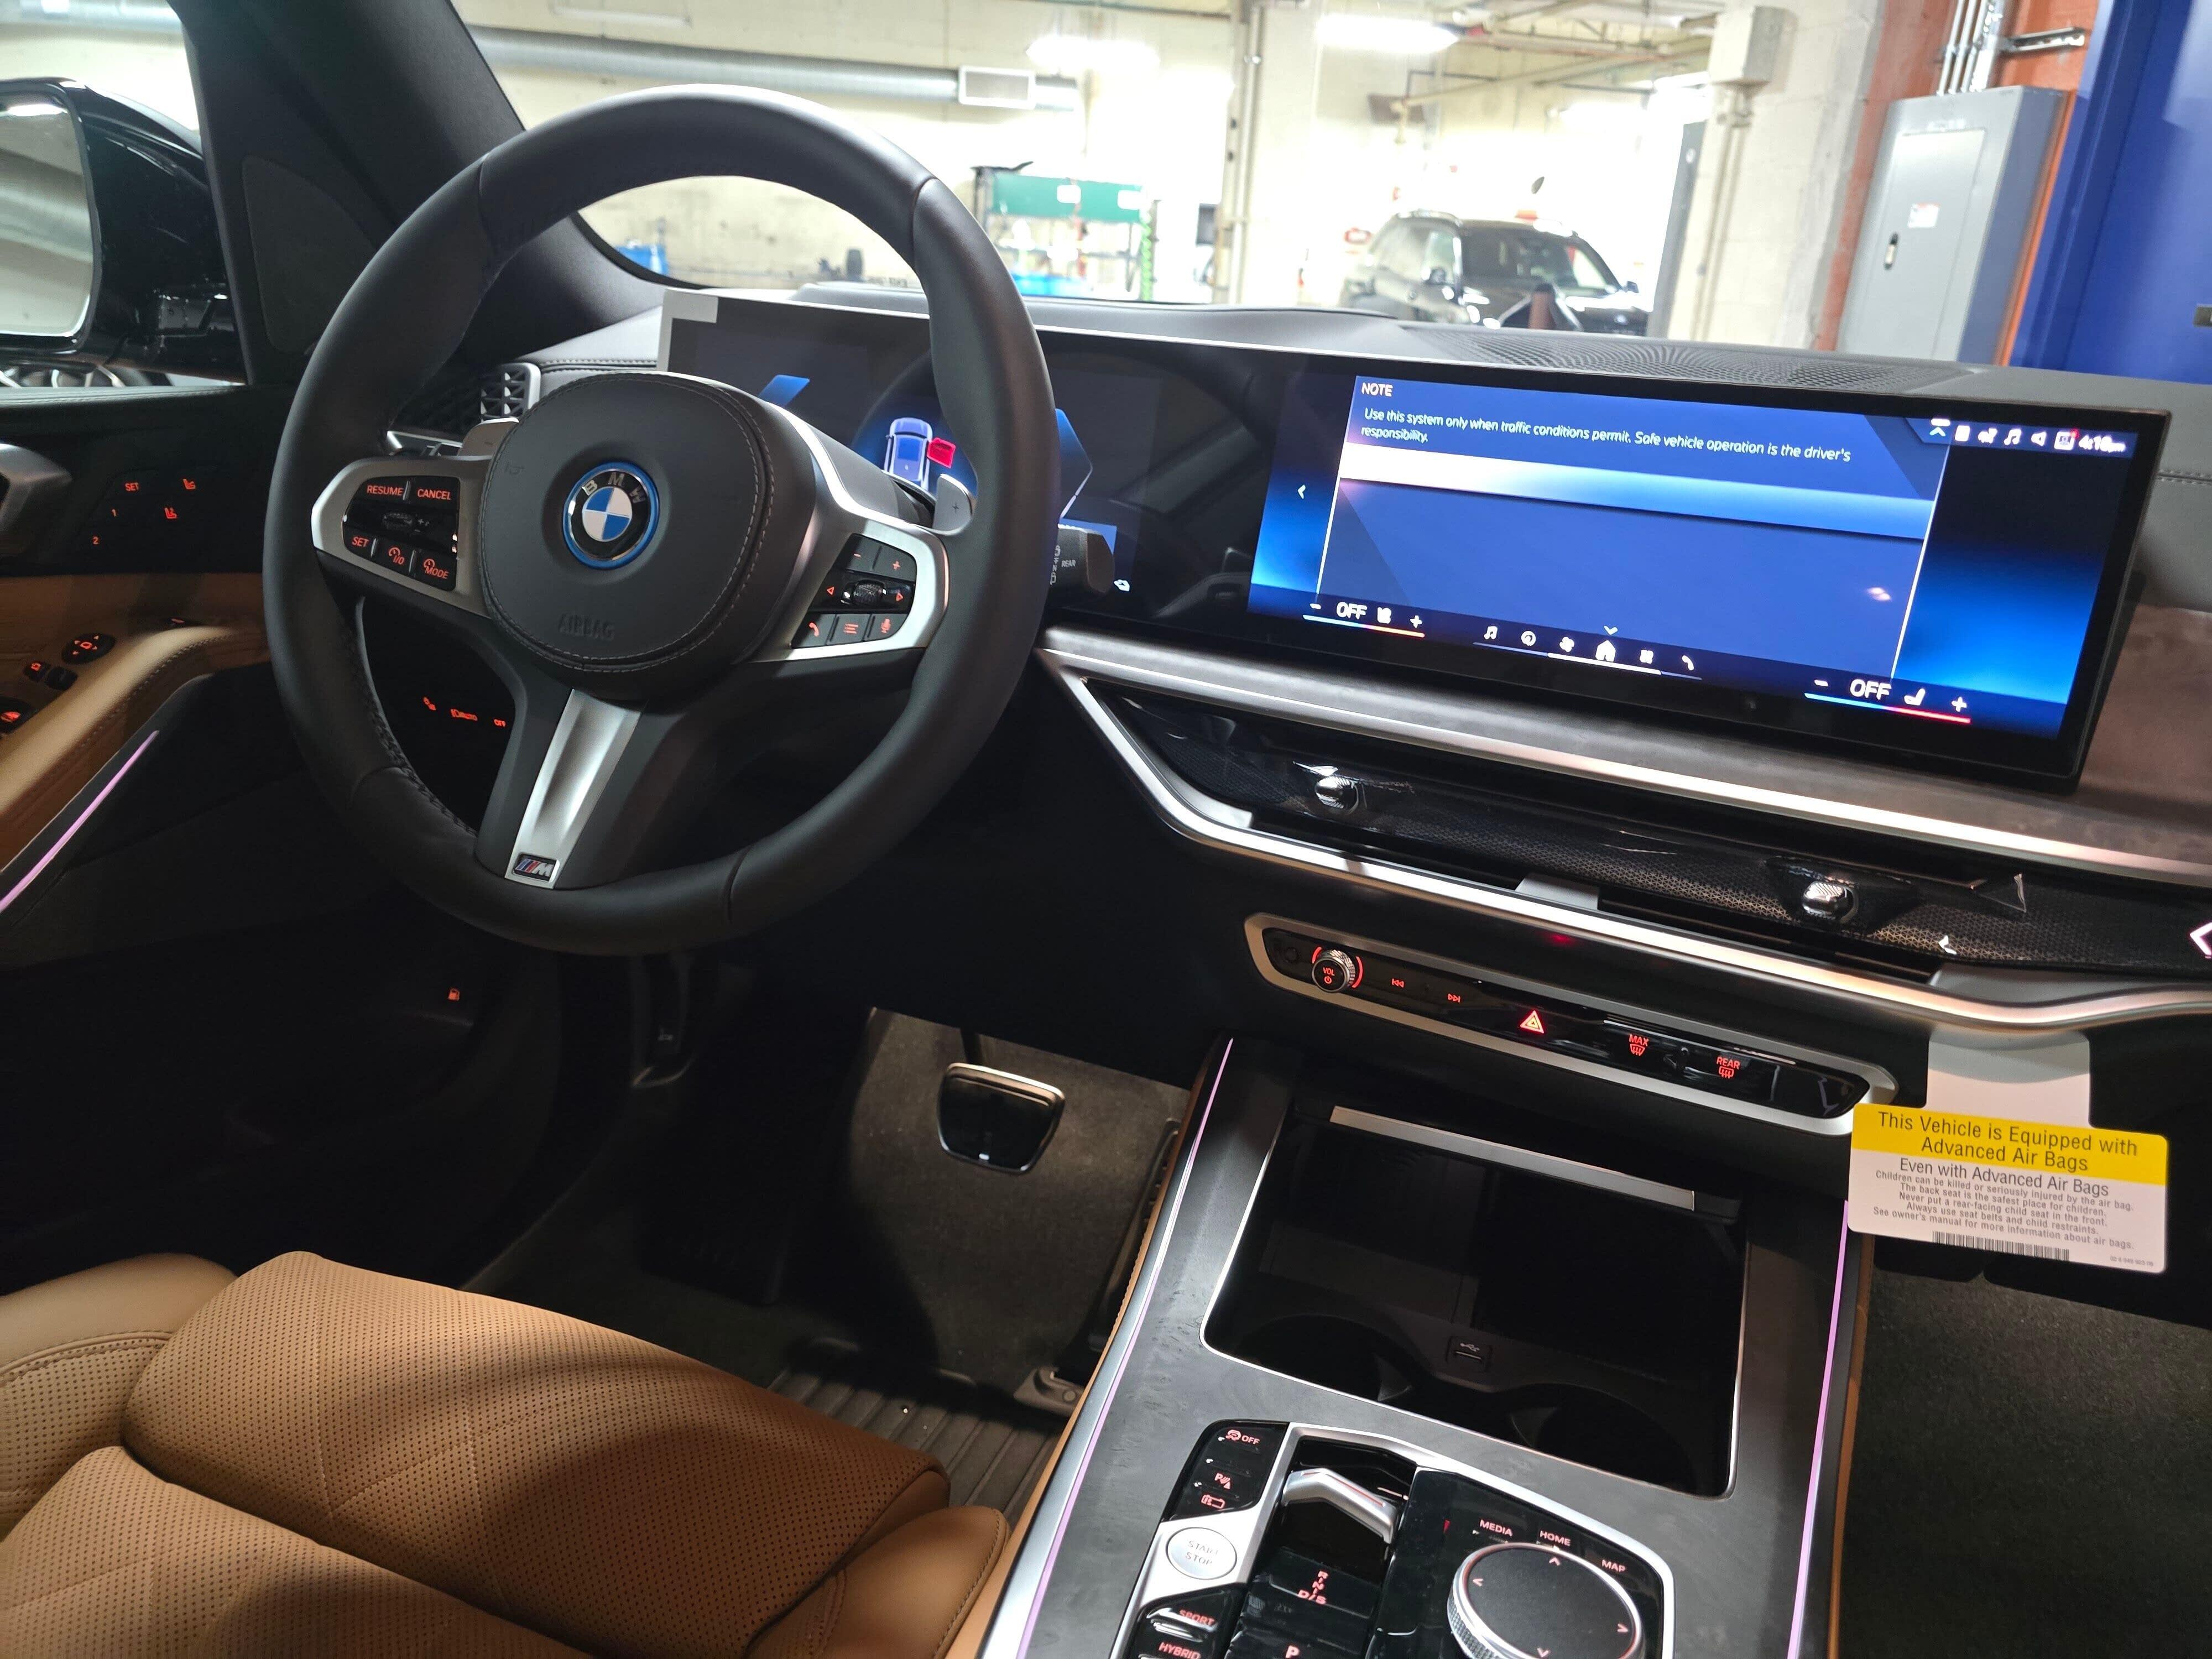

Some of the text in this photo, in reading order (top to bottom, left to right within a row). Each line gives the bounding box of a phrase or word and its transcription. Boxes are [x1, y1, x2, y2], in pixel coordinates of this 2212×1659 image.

[1361, 382, 1392, 397] NOTE
[1360, 427, 1427, 442] responsibility.
[1365, 408, 1850, 461] Use this system only when traffic conditions permit. Safe vehicle operation is the driver's
[2079, 434, 2126, 453] 4:1pm
[125, 482, 139, 492] SET
[367, 485, 404, 497] RESUME
[417, 488, 452, 501] CANCEL
[581, 472, 645, 503] BMW
[112, 509, 117, 517] 1
[92, 536, 100, 545] 2
[351, 536, 370, 548] SET
[424, 566, 449, 580] MODE
[1336, 602, 1367, 619] OFF
[1850, 679, 1892, 700] OFF
[1322, 967, 1335, 977] VOL
[1629, 1034, 1650, 1047] MAX
[1717, 1056, 1741, 1070] REAR
[1877, 1110, 2137, 1156] This Vehicle is Equipped with
[1921, 1136, 2088, 1173] Advanced Air Bags
[1900, 1156, 2109, 1198] Even with Advanced Air Bags
[1875, 1170, 2133, 1211] Children can be killed or seriously injured by the air bag.
[1900, 1181, 2106, 1217] The back seat is the safest place for children.
[1898, 1191, 2107, 1227] Never put a rear-facing child seat in the front.
[1906, 1201, 2099, 1234] Always use seat belts and child restraints.
[1873, 1206, 2134, 1249] See owner's manual for more information about air bags.
[1241, 1435, 1260, 1446] OFF
[1480, 1519, 1513, 1537] MEDIA
[1540, 1530, 1571, 1547] HOME
[1601, 1559, 1626, 1573] MAP
[1317, 1570, 1329, 1579] R
[1312, 1580, 1324, 1590] N
[1297, 1589, 1327, 1605] D/S
[1180, 1610, 1215, 1626] SPORT
[1158, 1641, 1202, 1659] HYBRID
[1285, 1645, 1301, 1659] P
